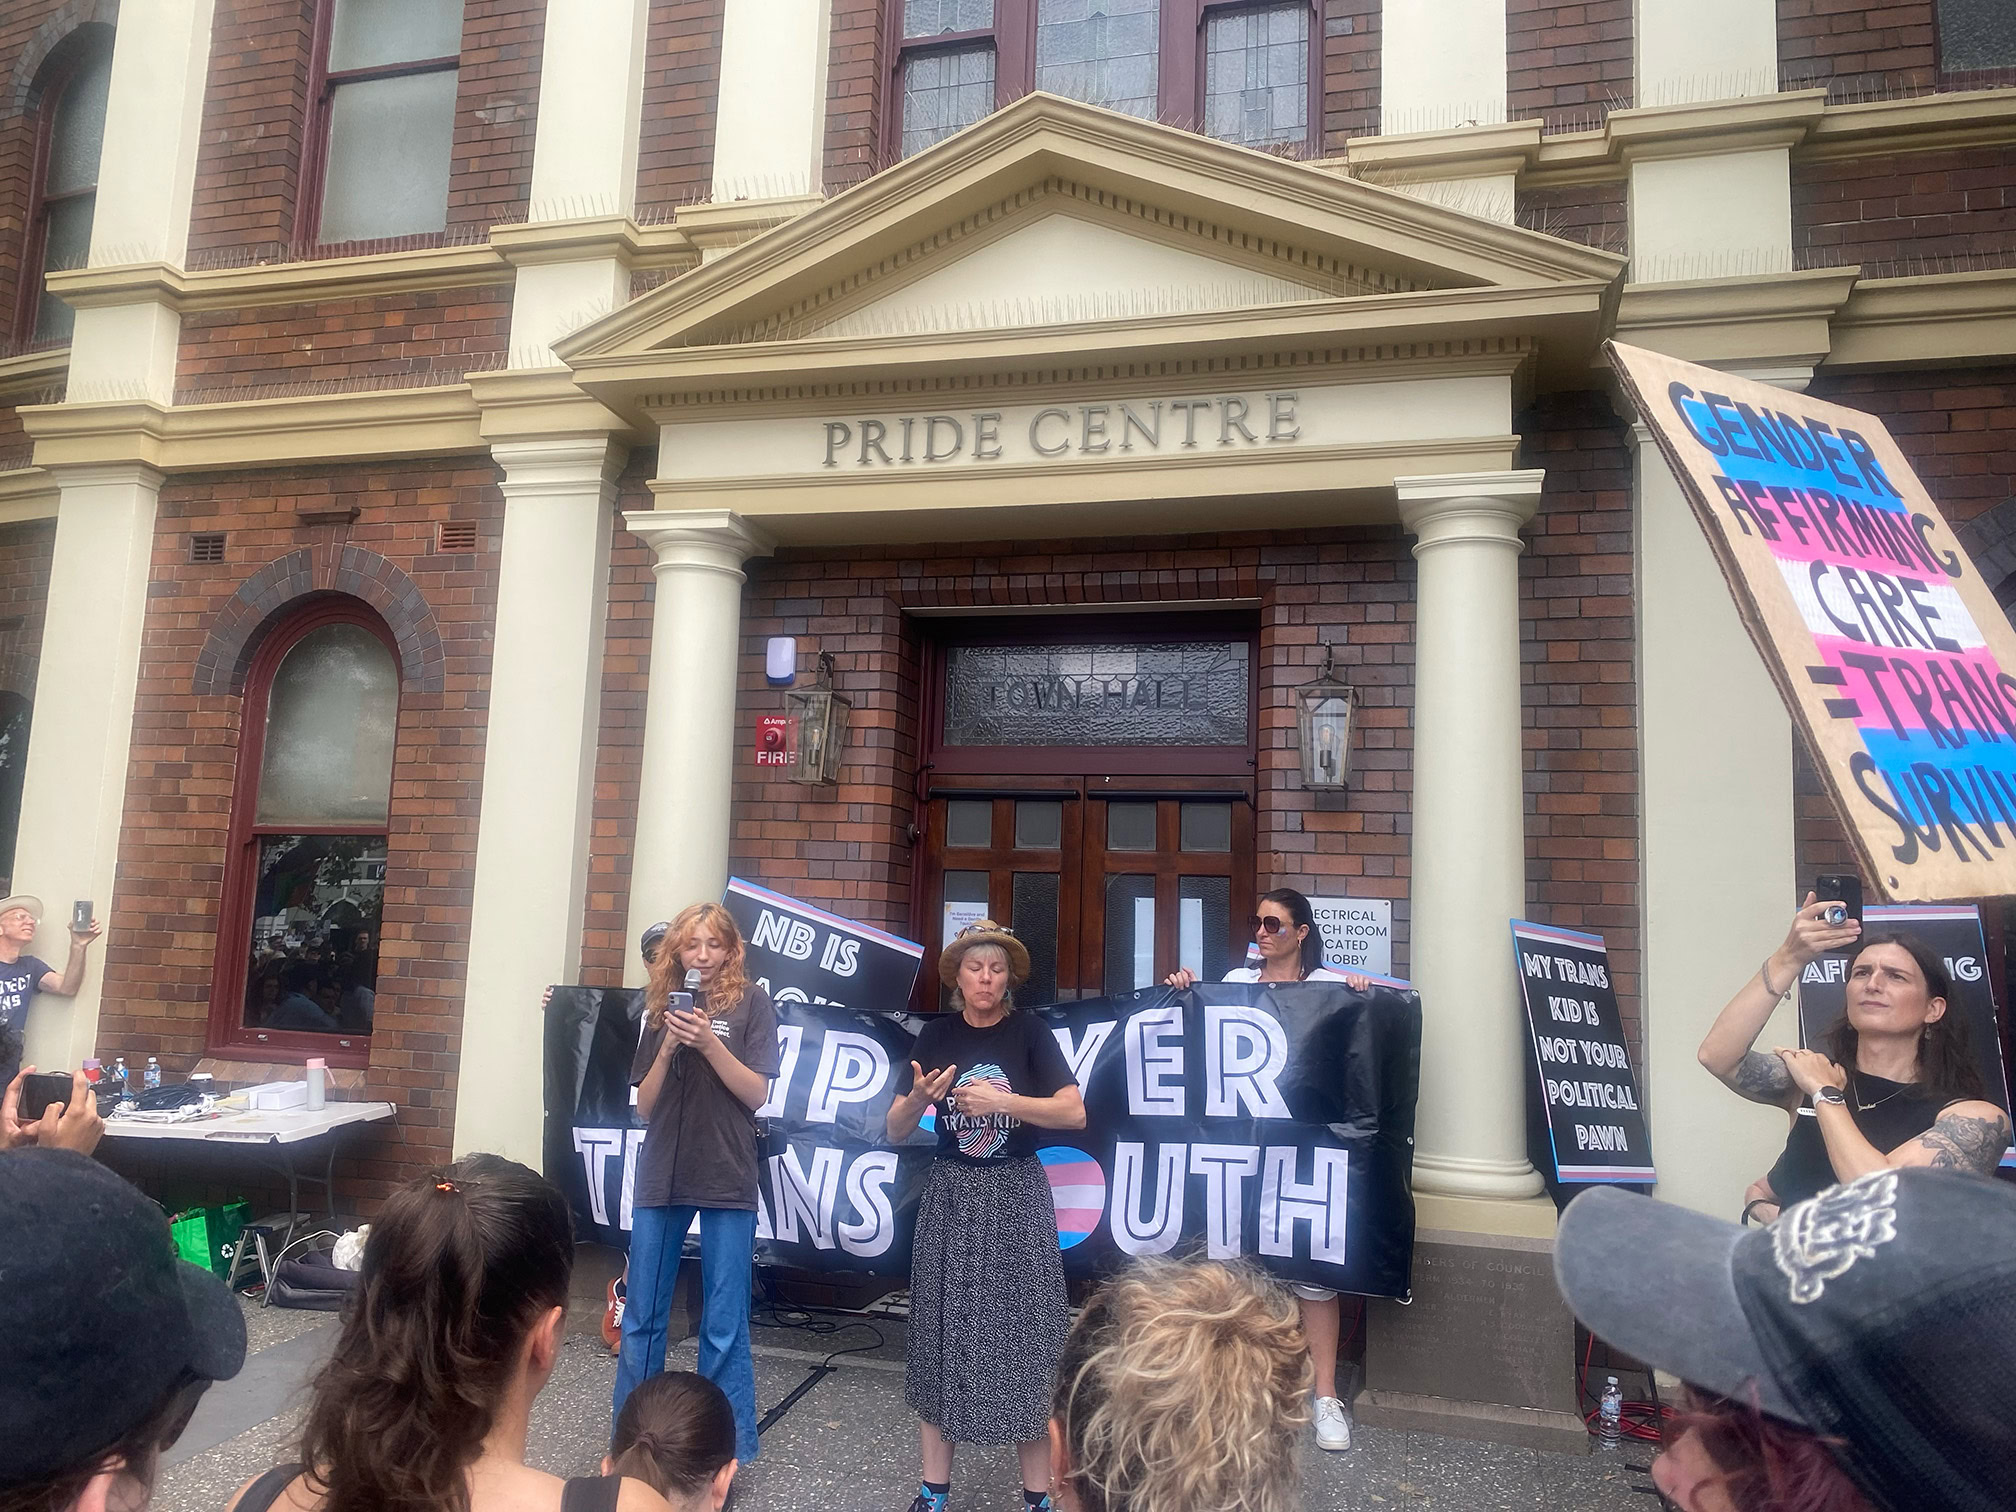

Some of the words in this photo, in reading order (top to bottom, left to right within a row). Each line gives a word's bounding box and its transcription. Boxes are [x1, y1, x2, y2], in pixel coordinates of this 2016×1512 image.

[822, 411, 1002, 467] PRIDE
[1028, 391, 1301, 456] CENTRE
[1667, 381, 1905, 499] GENDER
[1711, 474, 1963, 579] AFFIRMING
[1808, 559, 1961, 653] CARE
[981, 680, 1084, 710] TOWN
[1102, 679, 1208, 710] HALL
[770, 718, 792, 726] Ampc
[757, 751, 796, 764] FIRE
[1313, 908, 1377, 922] ECTRICAL
[1346, 924, 1387, 937] ROOM
[751, 908, 816, 961] NB
[819, 932, 861, 978] IS
[1323, 938, 1368, 951] CATED
[1523, 952, 1552, 979] MY
[1555, 957, 1609, 989] TRANS
[1548, 995, 1582, 1024] KID
[1583, 1000, 1600, 1027] IS
[712, 1029, 730, 1038] roject.
[1538, 1035, 1578, 1065] NOT
[1578, 1038, 1628, 1069] YOUR
[1546, 1079, 1637, 1111] POLITICAL
[1575, 1123, 1628, 1152] PAWN
[572, 1126, 899, 1258] TNS
[1413, 1256, 1455, 1268] MBERS
[1487, 1262, 1545, 1276] COUNCIL
